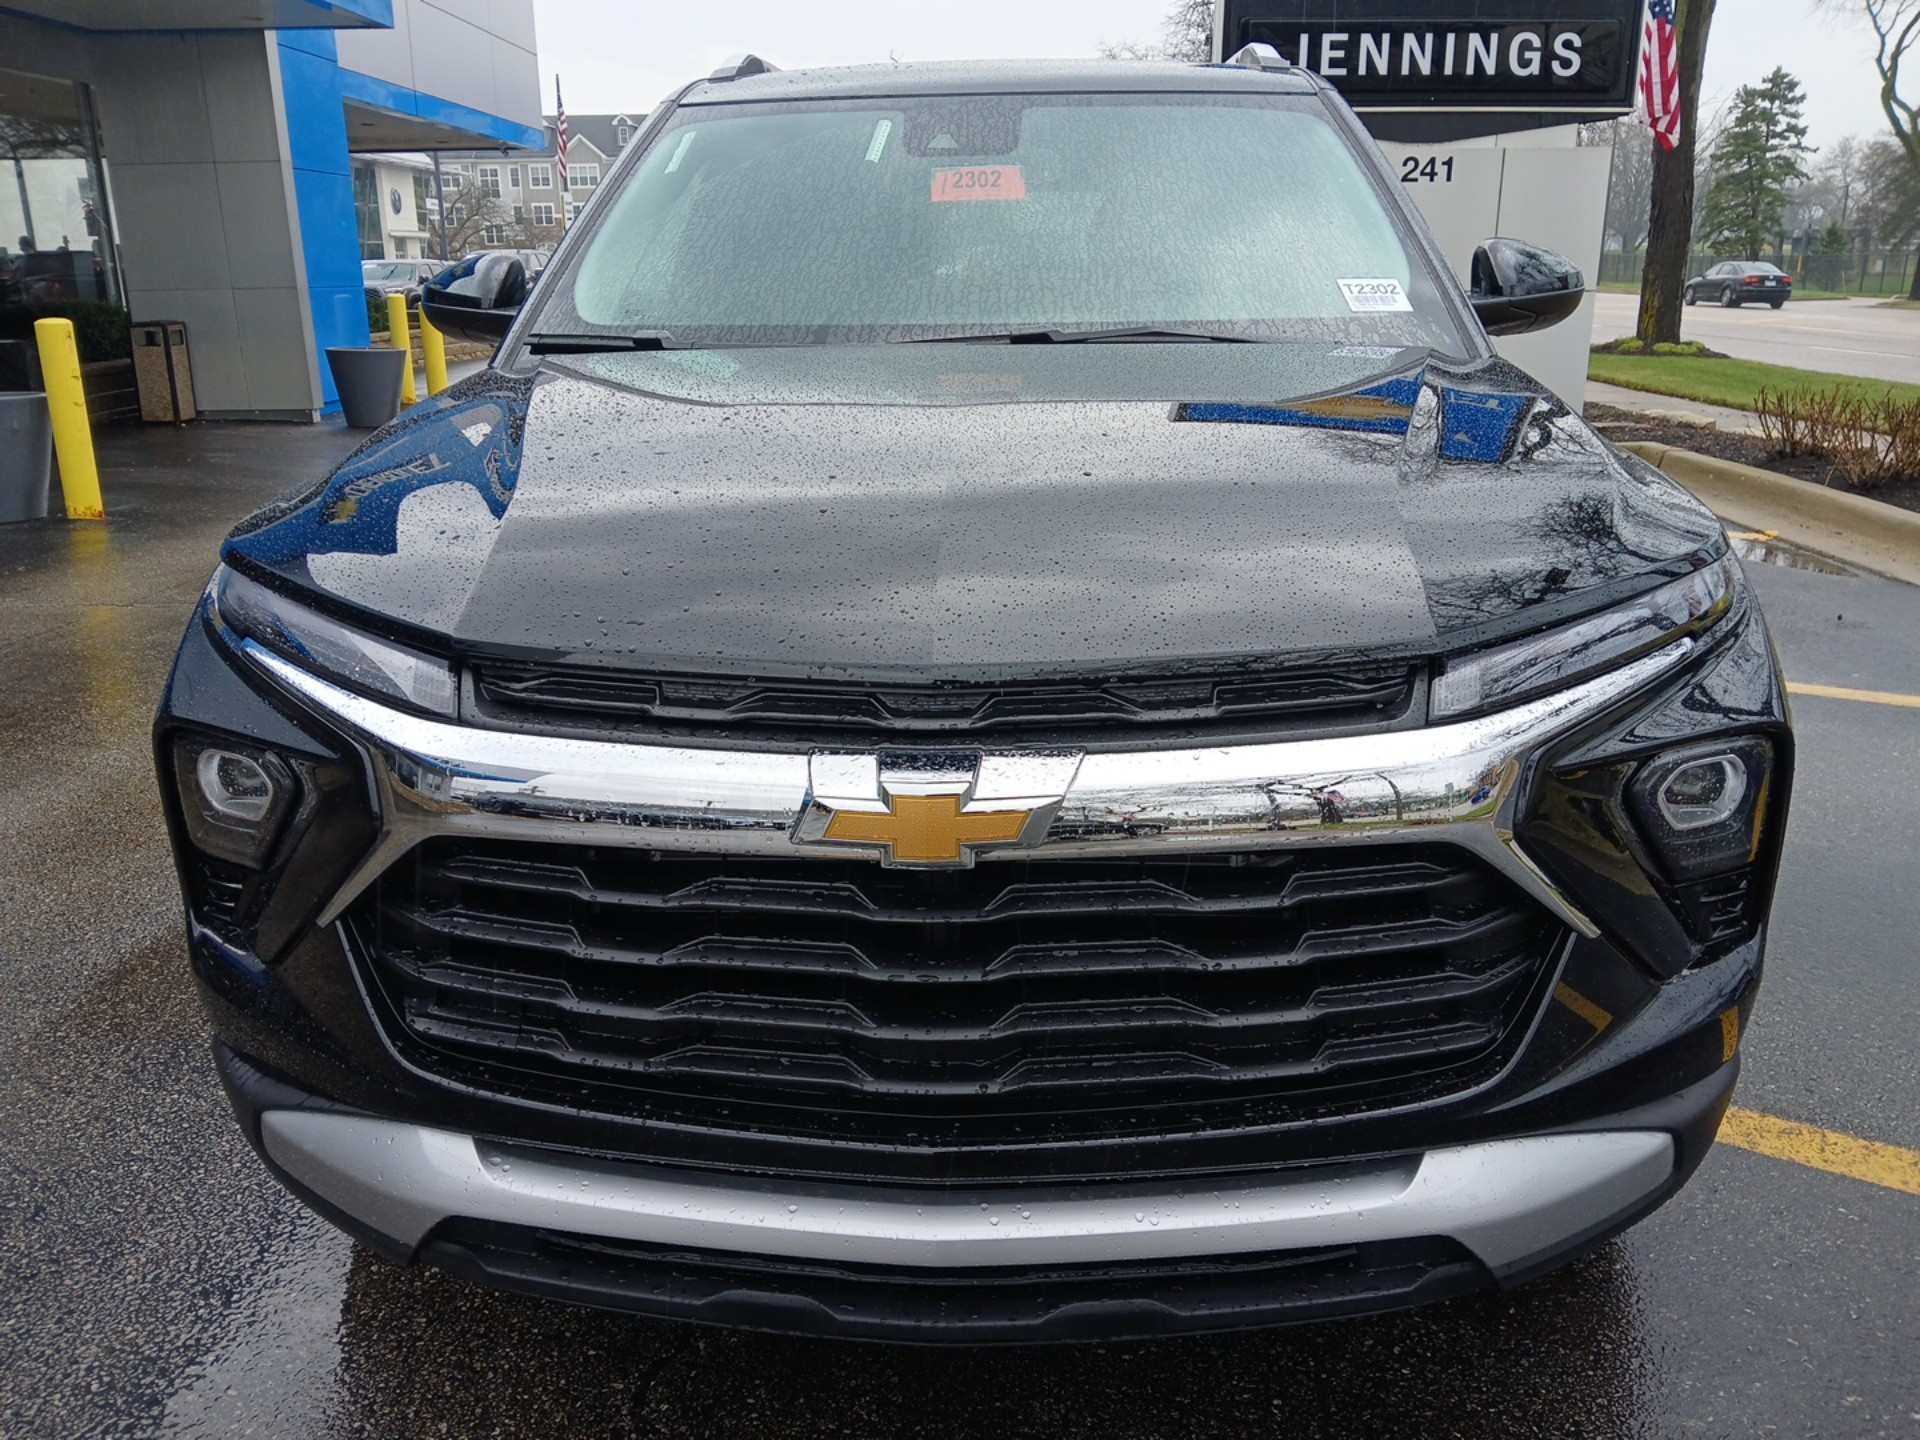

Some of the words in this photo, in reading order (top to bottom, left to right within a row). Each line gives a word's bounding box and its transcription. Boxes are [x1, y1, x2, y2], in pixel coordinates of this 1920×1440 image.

[1298, 31, 1582, 77] JENNINGS
[1400, 155, 1454, 182] 241
[1342, 283, 1401, 295] T2302
